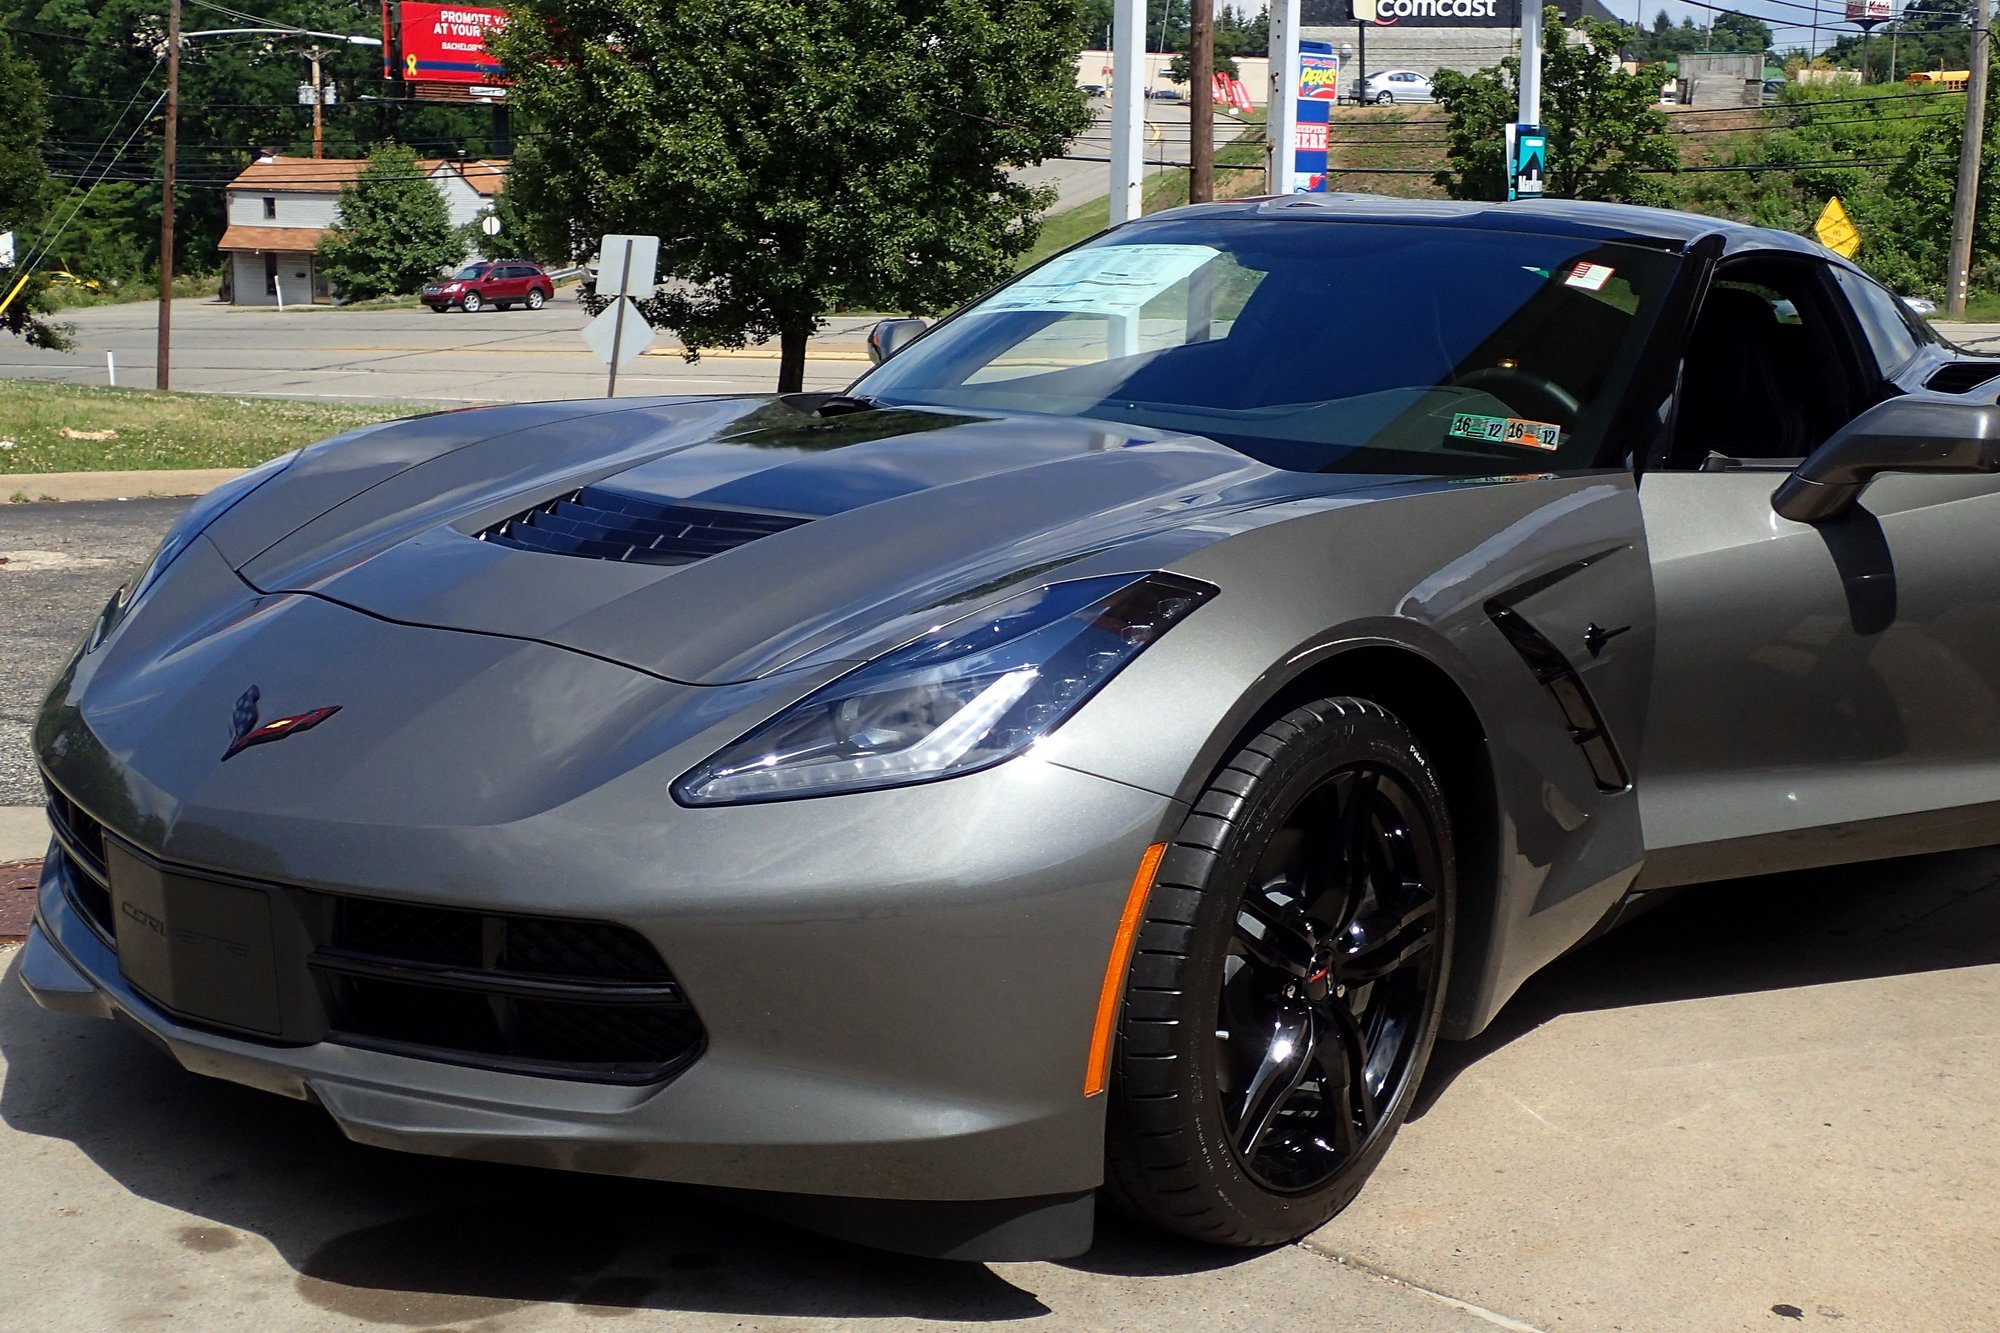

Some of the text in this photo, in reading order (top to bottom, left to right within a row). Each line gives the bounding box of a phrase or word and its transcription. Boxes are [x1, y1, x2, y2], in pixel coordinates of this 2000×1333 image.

[1377, 0, 1496, 17] comcast
[440, 10, 492, 27] PROMOTE
[433, 22, 449, 35] AT
[450, 23, 481, 37] YOUR
[1300, 67, 1336, 87] PERKS
[1296, 124, 1327, 134] CCEPTED
[1295, 133, 1327, 149] HERE
[1454, 416, 1503, 438] 16 12
[1507, 422, 1556, 446] 16 12
